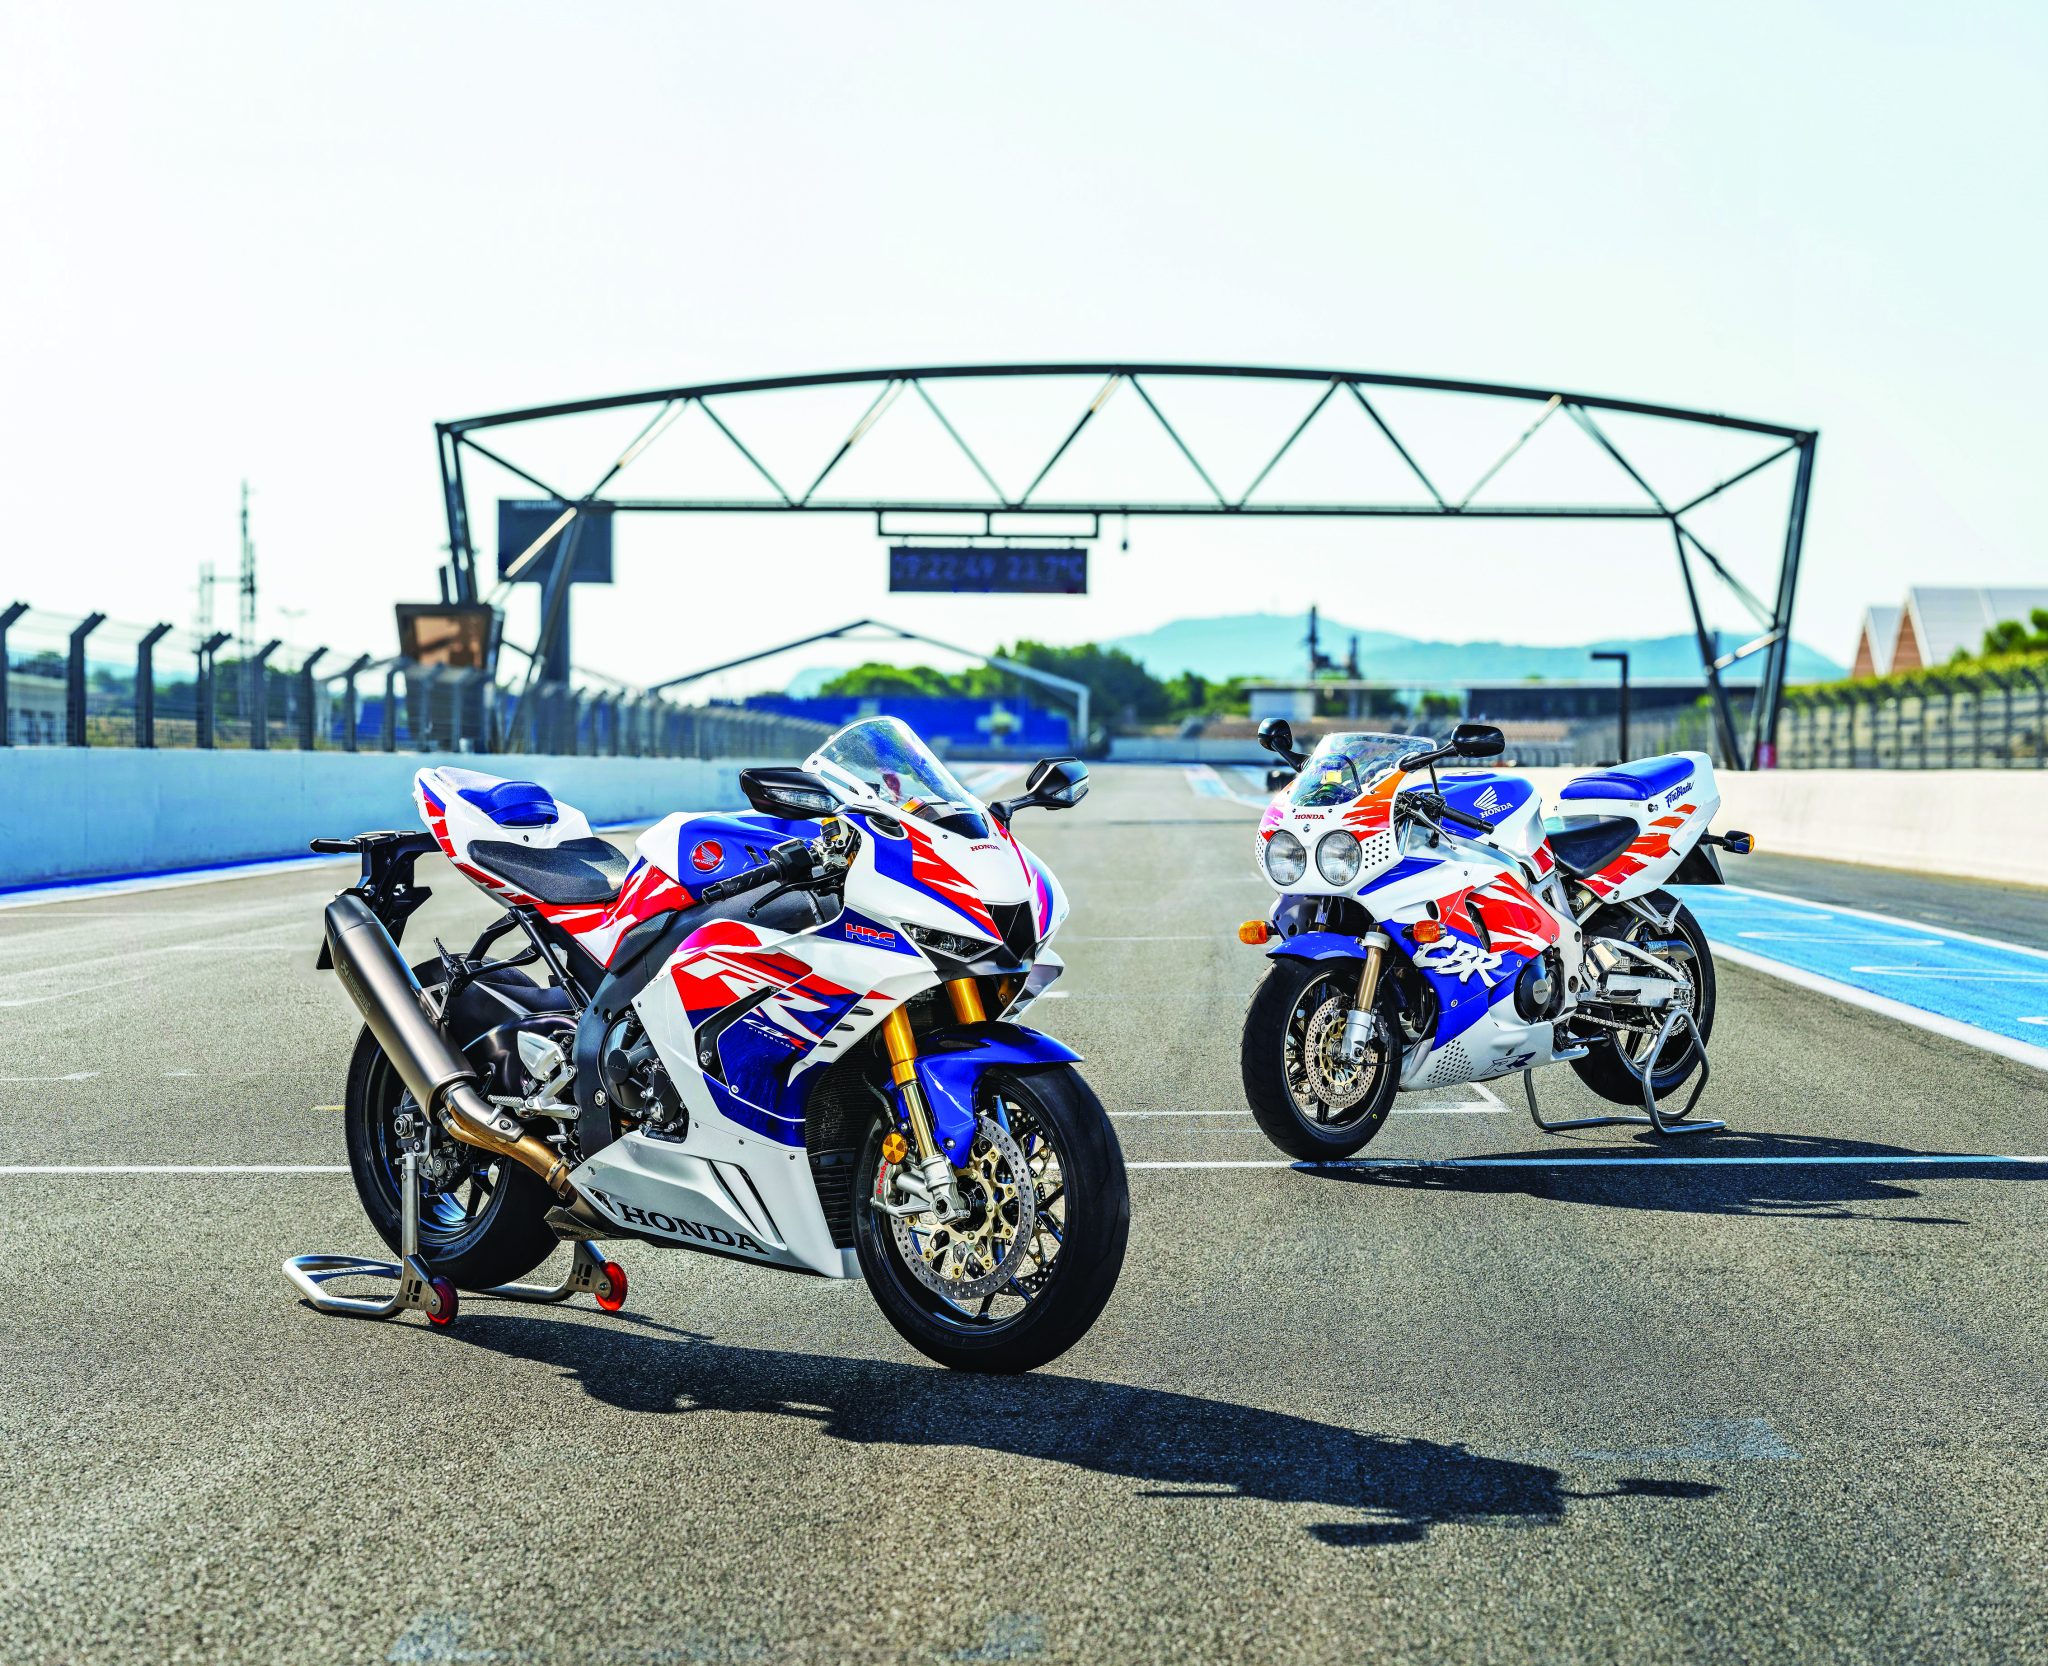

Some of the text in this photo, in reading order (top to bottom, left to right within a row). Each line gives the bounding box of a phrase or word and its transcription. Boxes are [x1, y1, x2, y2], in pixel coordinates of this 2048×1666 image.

[1480, 802, 1514, 818] HONDA
[845, 922, 896, 948] HRC
[1412, 934, 1503, 988] CBR
[742, 1018, 809, 1052] CBR
[617, 1201, 771, 1256] HONDA
